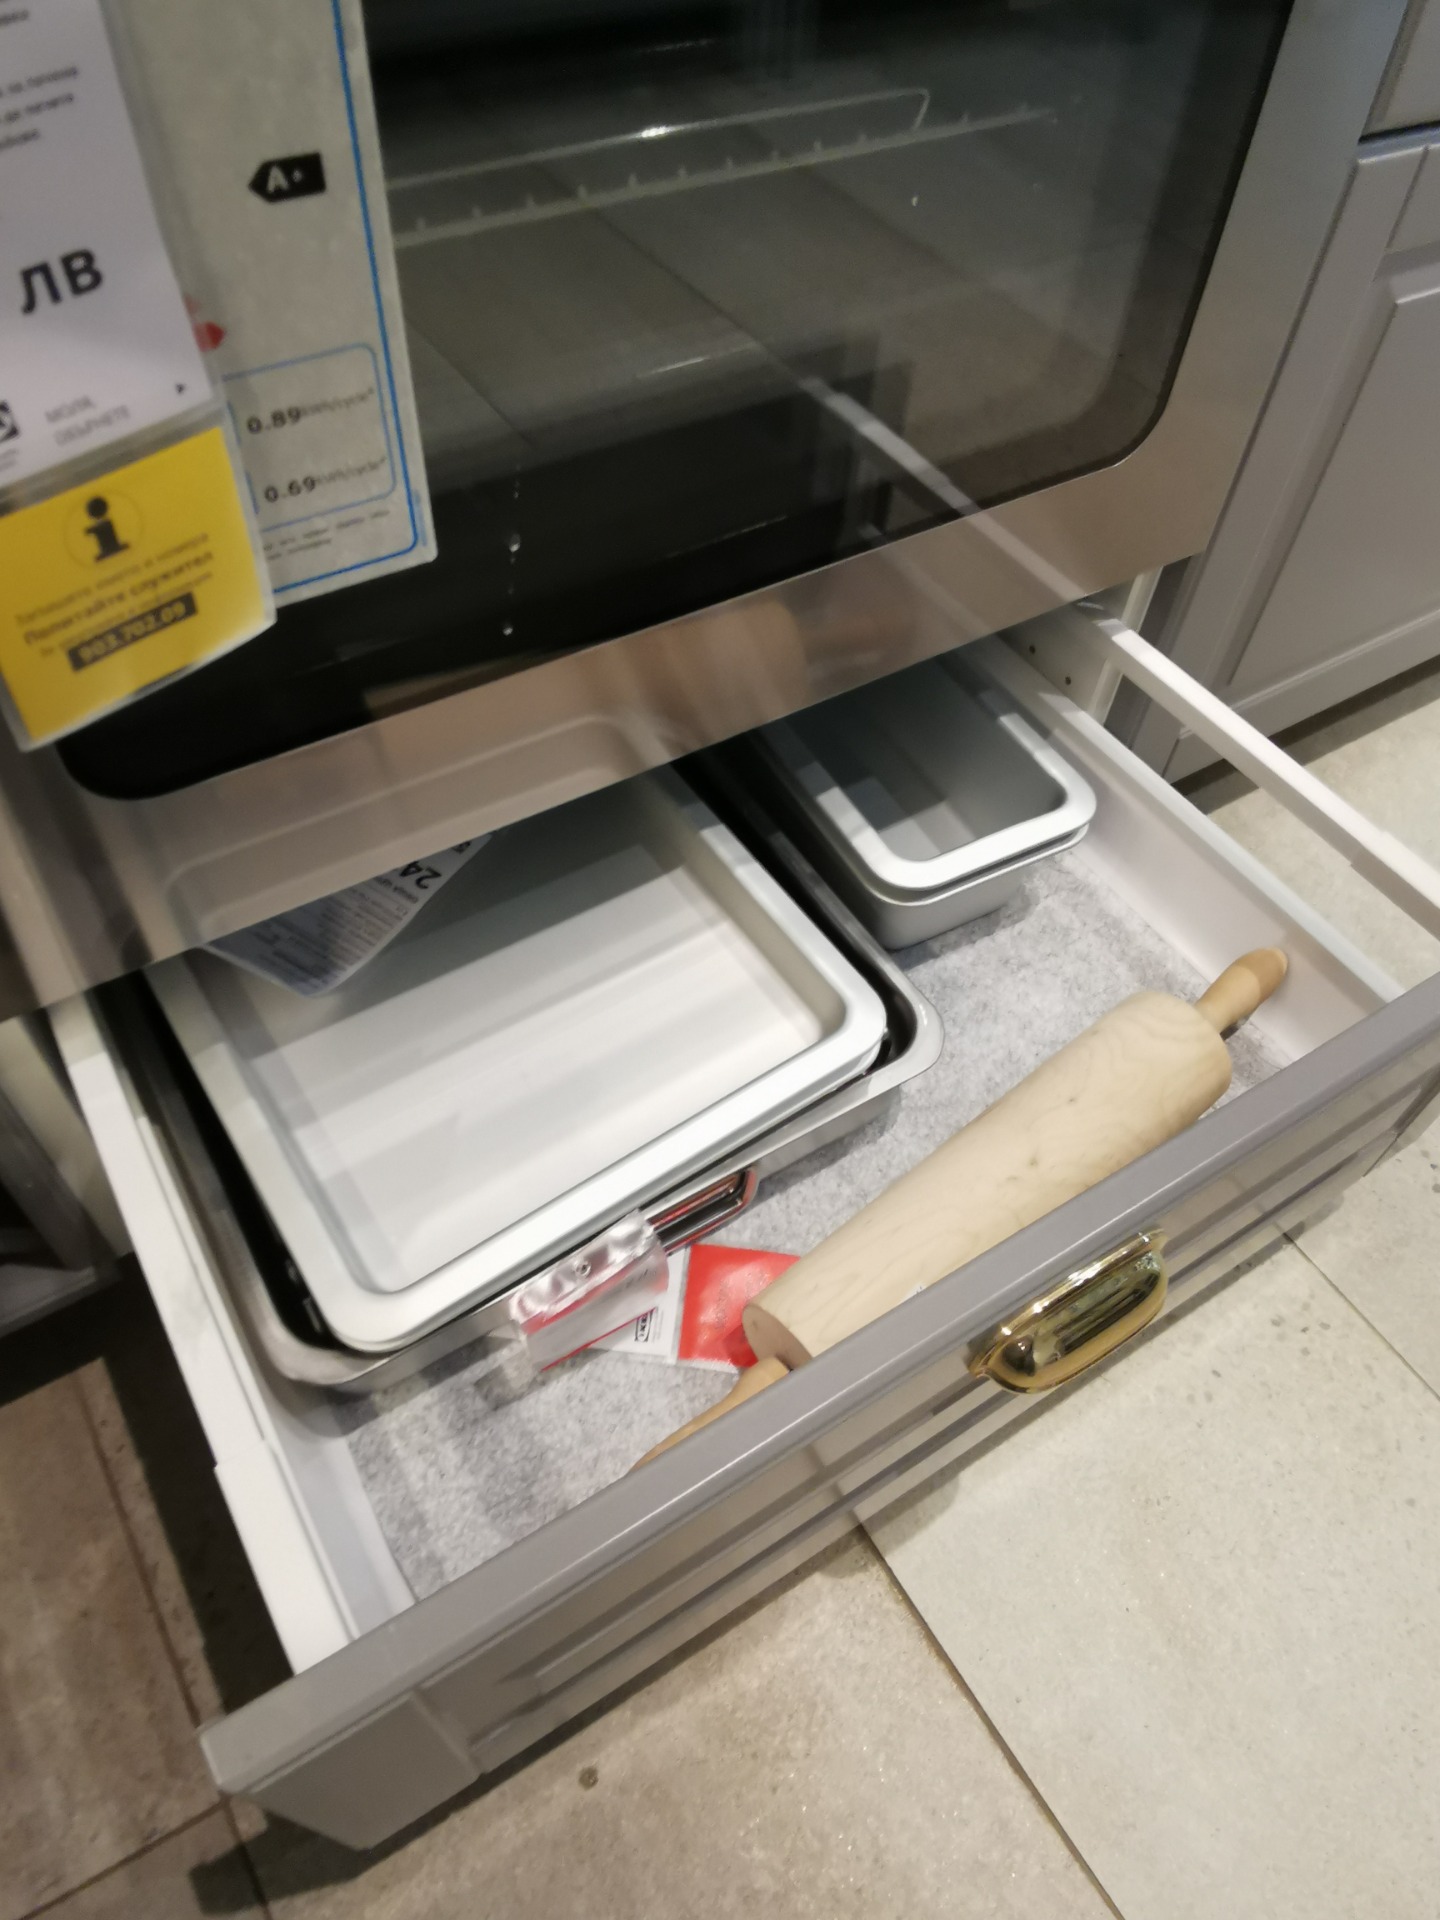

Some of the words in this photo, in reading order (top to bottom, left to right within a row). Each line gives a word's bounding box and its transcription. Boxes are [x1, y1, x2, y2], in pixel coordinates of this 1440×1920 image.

[20, 248, 103, 316] ЛВ
[246, 407, 301, 435] 0.89
[264, 475, 316, 503] 0.69
